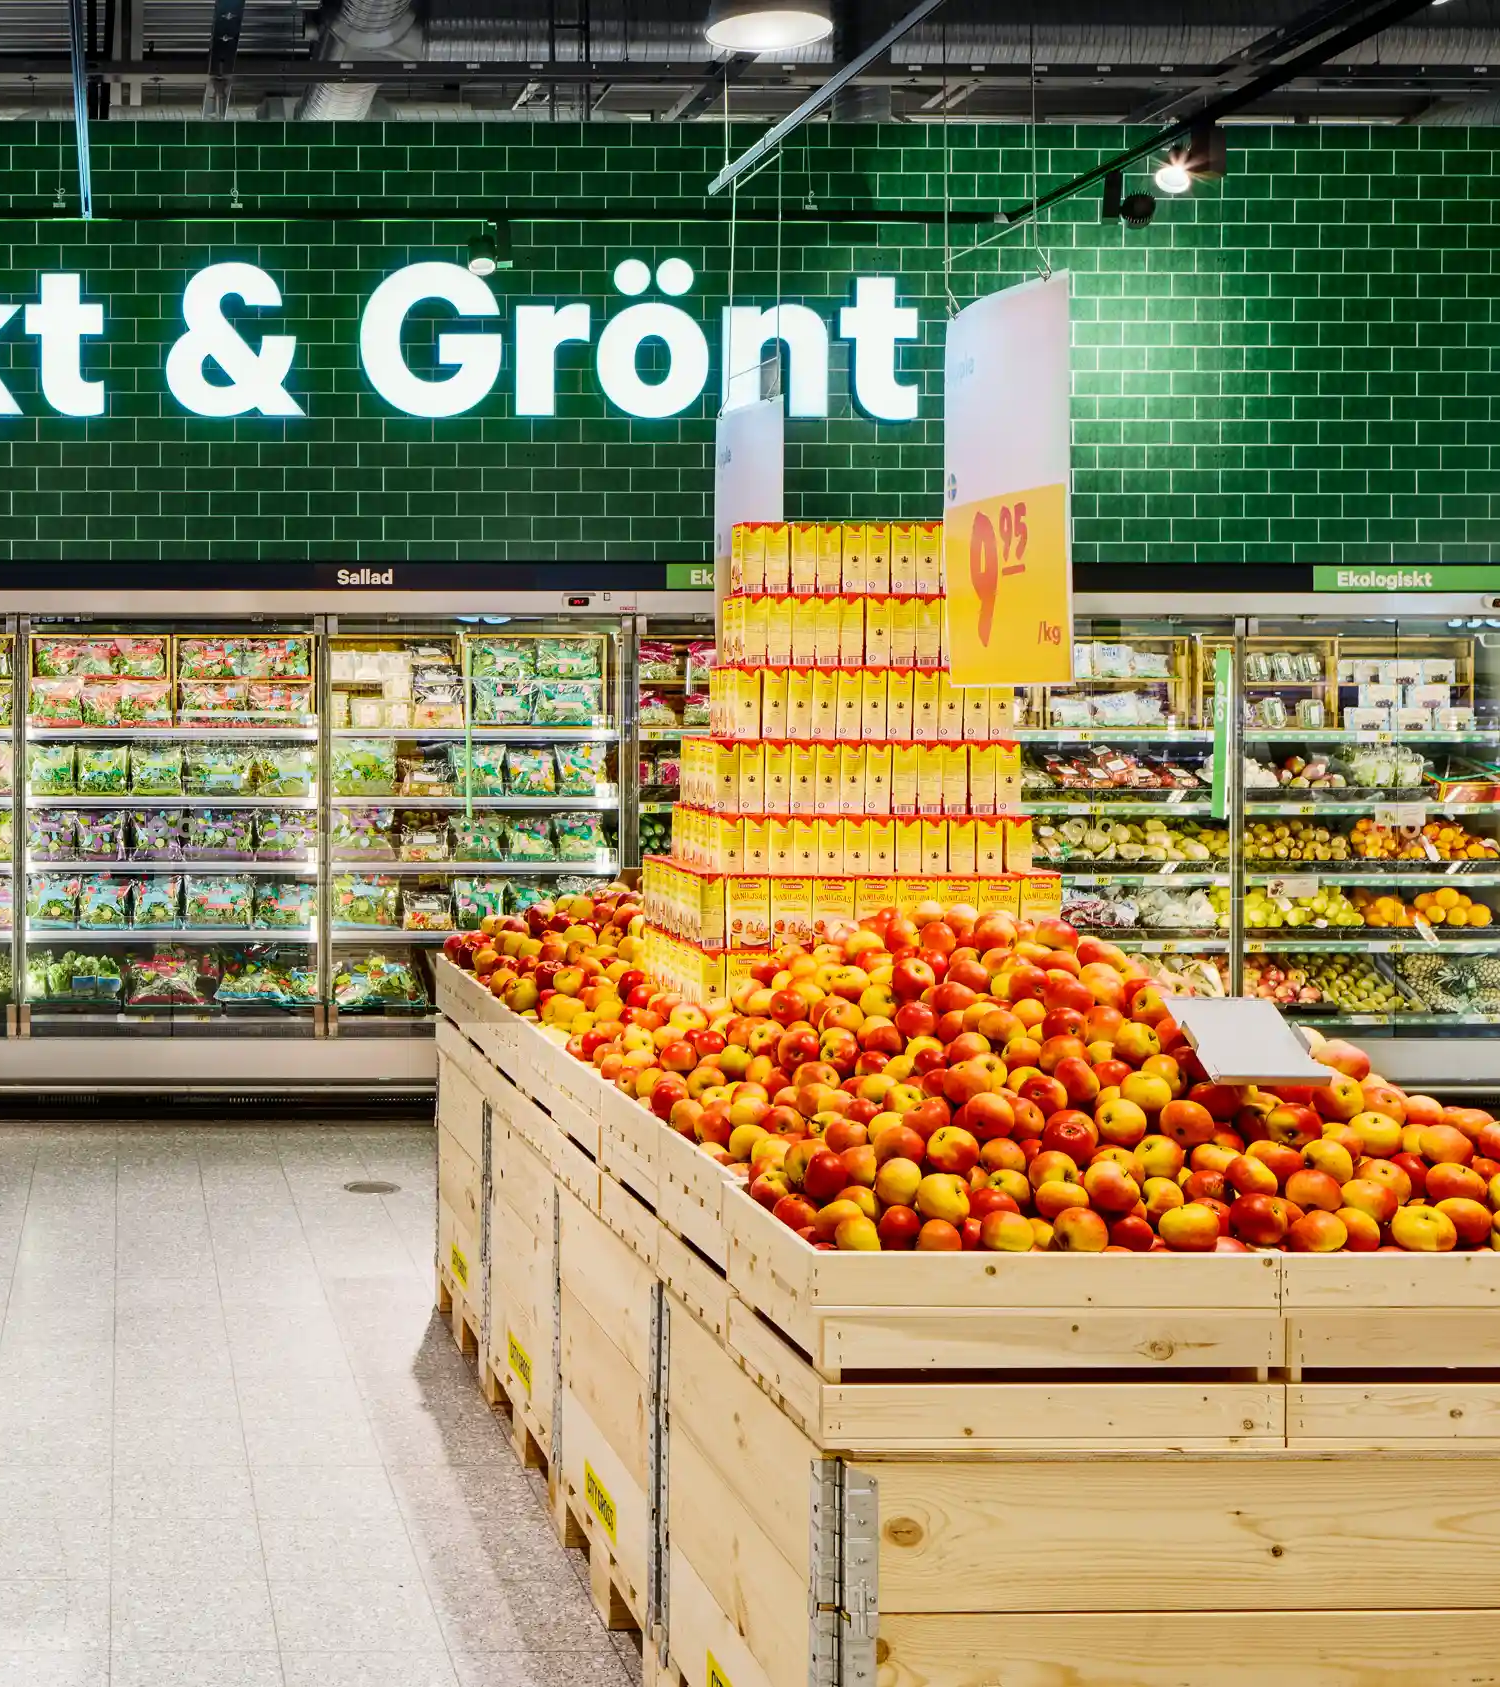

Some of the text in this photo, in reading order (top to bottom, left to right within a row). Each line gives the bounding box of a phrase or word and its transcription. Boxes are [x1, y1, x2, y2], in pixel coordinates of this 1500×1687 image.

[167, 262, 303, 418] &
[361, 258, 920, 420] Grönt
[337, 569, 394, 586] Sallad
[969, 511, 998, 648] 9
[1337, 570, 1433, 591] Ekologiskt
[1037, 620, 1063, 646] /kg
[587, 1472, 614, 1532] CITY GROSS
